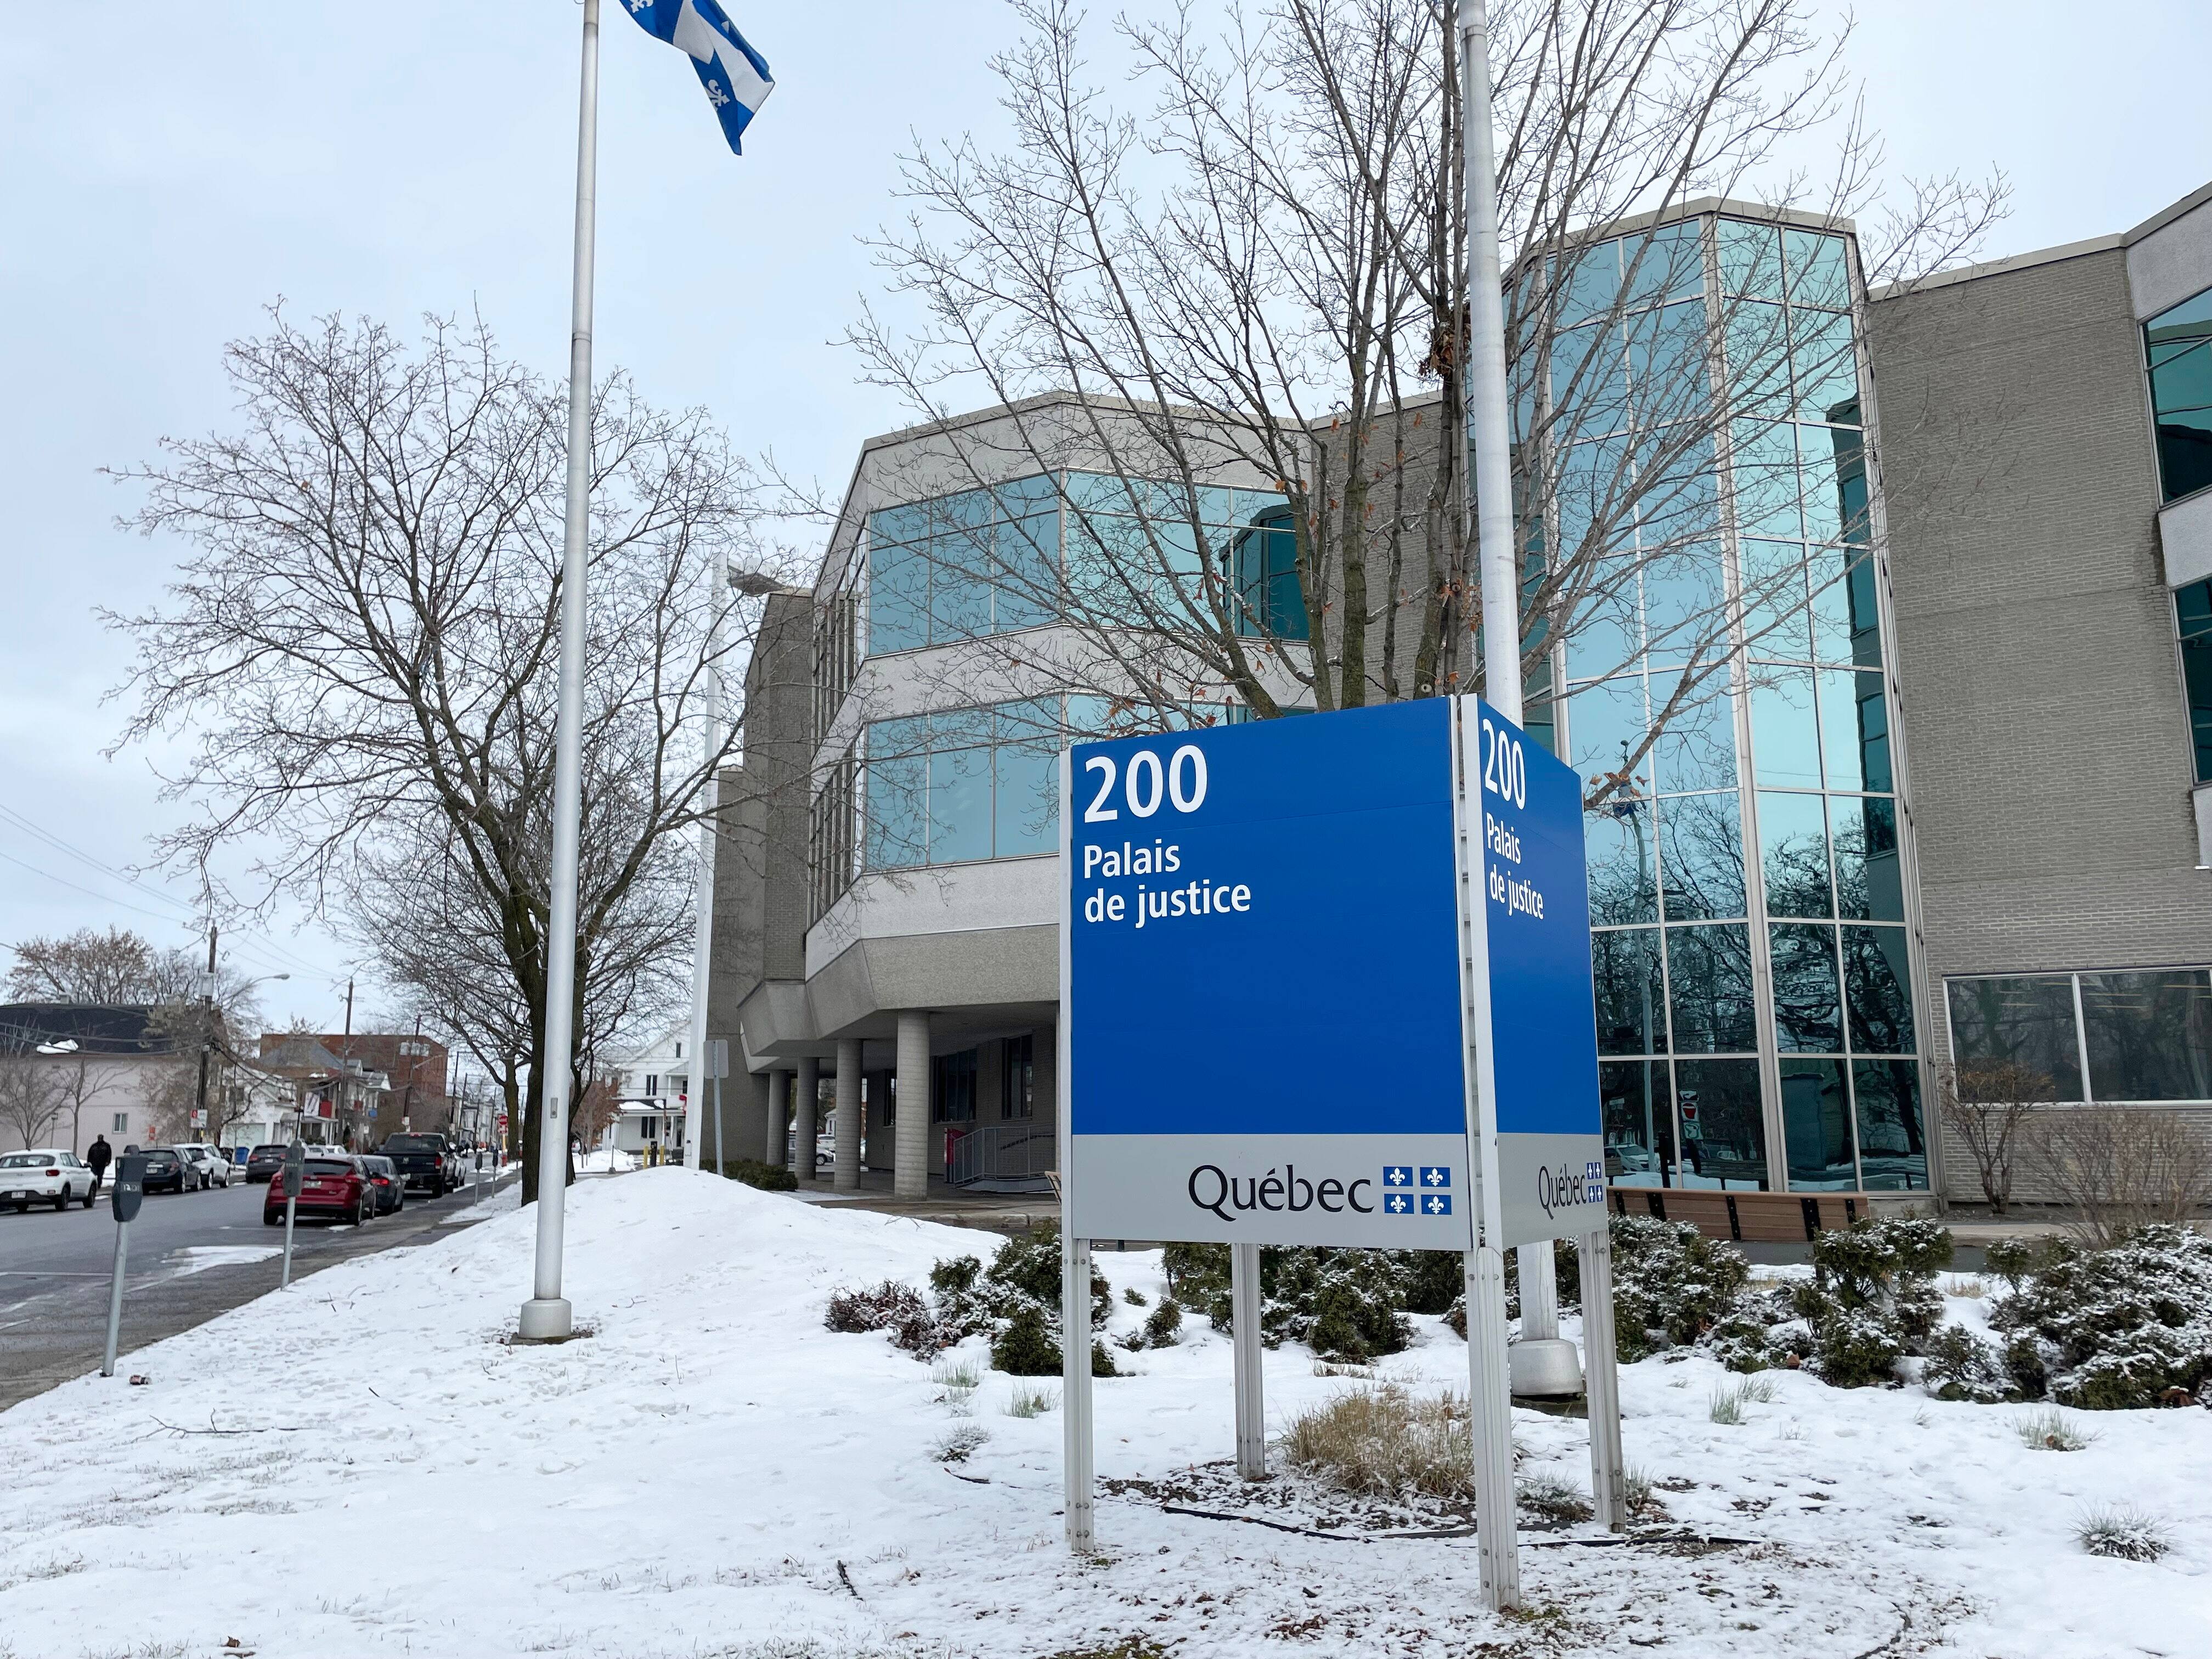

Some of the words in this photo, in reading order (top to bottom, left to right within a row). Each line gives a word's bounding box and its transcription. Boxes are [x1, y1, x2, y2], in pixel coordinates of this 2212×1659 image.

[1084, 744, 1207, 823] 200
[1482, 719, 1526, 810] 200
[1084, 839, 1180, 879] Palais
[1486, 812, 1521, 865] Palais
[1085, 888, 1126, 923] de
[1135, 879, 1251, 928] justice
[1489, 864, 1505, 903] de
[1508, 870, 1544, 920] justice
[1188, 1164, 1375, 1222] Québec
[1538, 1163, 1587, 1220] Québec
